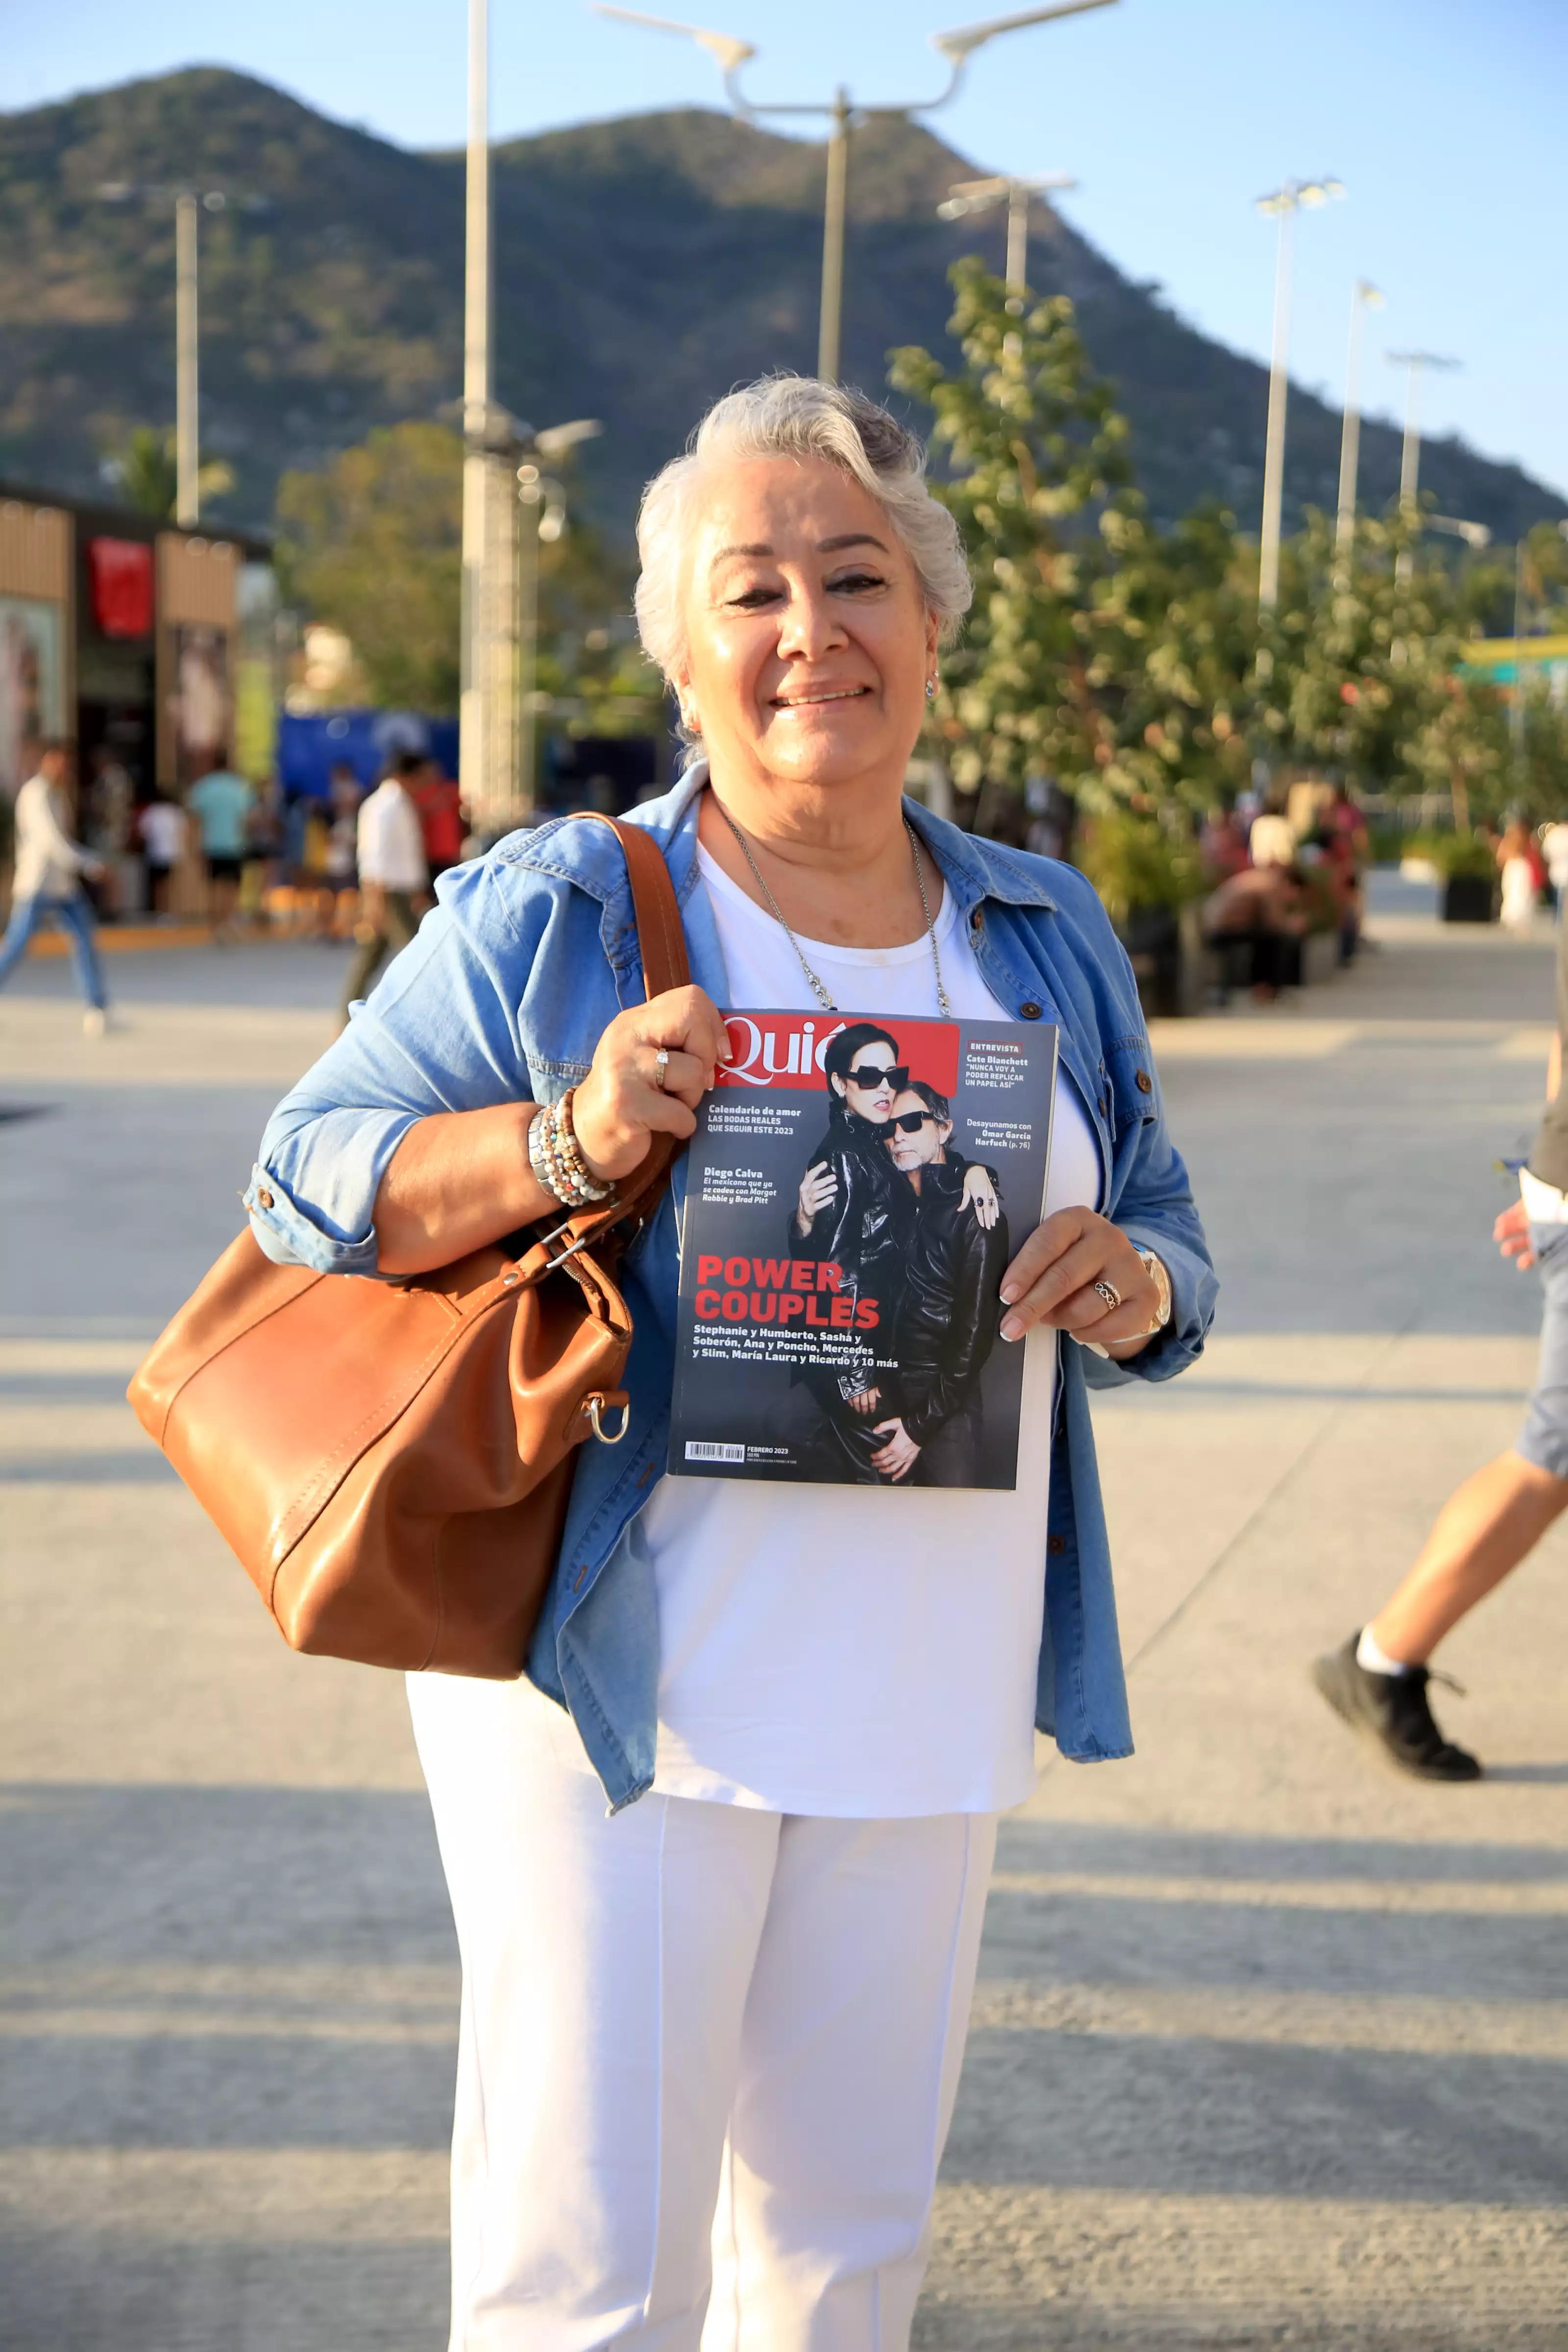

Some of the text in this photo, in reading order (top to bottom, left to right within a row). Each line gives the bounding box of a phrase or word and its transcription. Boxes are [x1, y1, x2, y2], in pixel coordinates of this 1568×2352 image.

[971, 1043, 1019, 1053] ENTREVISTA
[967, 1054, 1028, 1066] Cate Blanchett
[709, 1104, 760, 1114] Calendario
[762, 1106, 774, 1115] de
[967, 1118, 1017, 1129] Desayunamos
[1005, 1131, 1031, 1140] García
[975, 1138, 1007, 1147] Harfuch
[1009, 1141, 1018, 1149] (p.
[704, 1167, 762, 1178] Diego Calva
[750, 1188, 777, 1197] Margot
[697, 1254, 843, 1293] POWER
[694, 1289, 880, 1329] COUPLES
[694, 1324, 861, 1344] Stephanie y Humberto, Sasha y
[693, 1336, 873, 1355] Soberón, Ana y Poncho, Mercedes
[692, 1348, 899, 1368] y Slim, María Laura y Ricardo y 10 más
